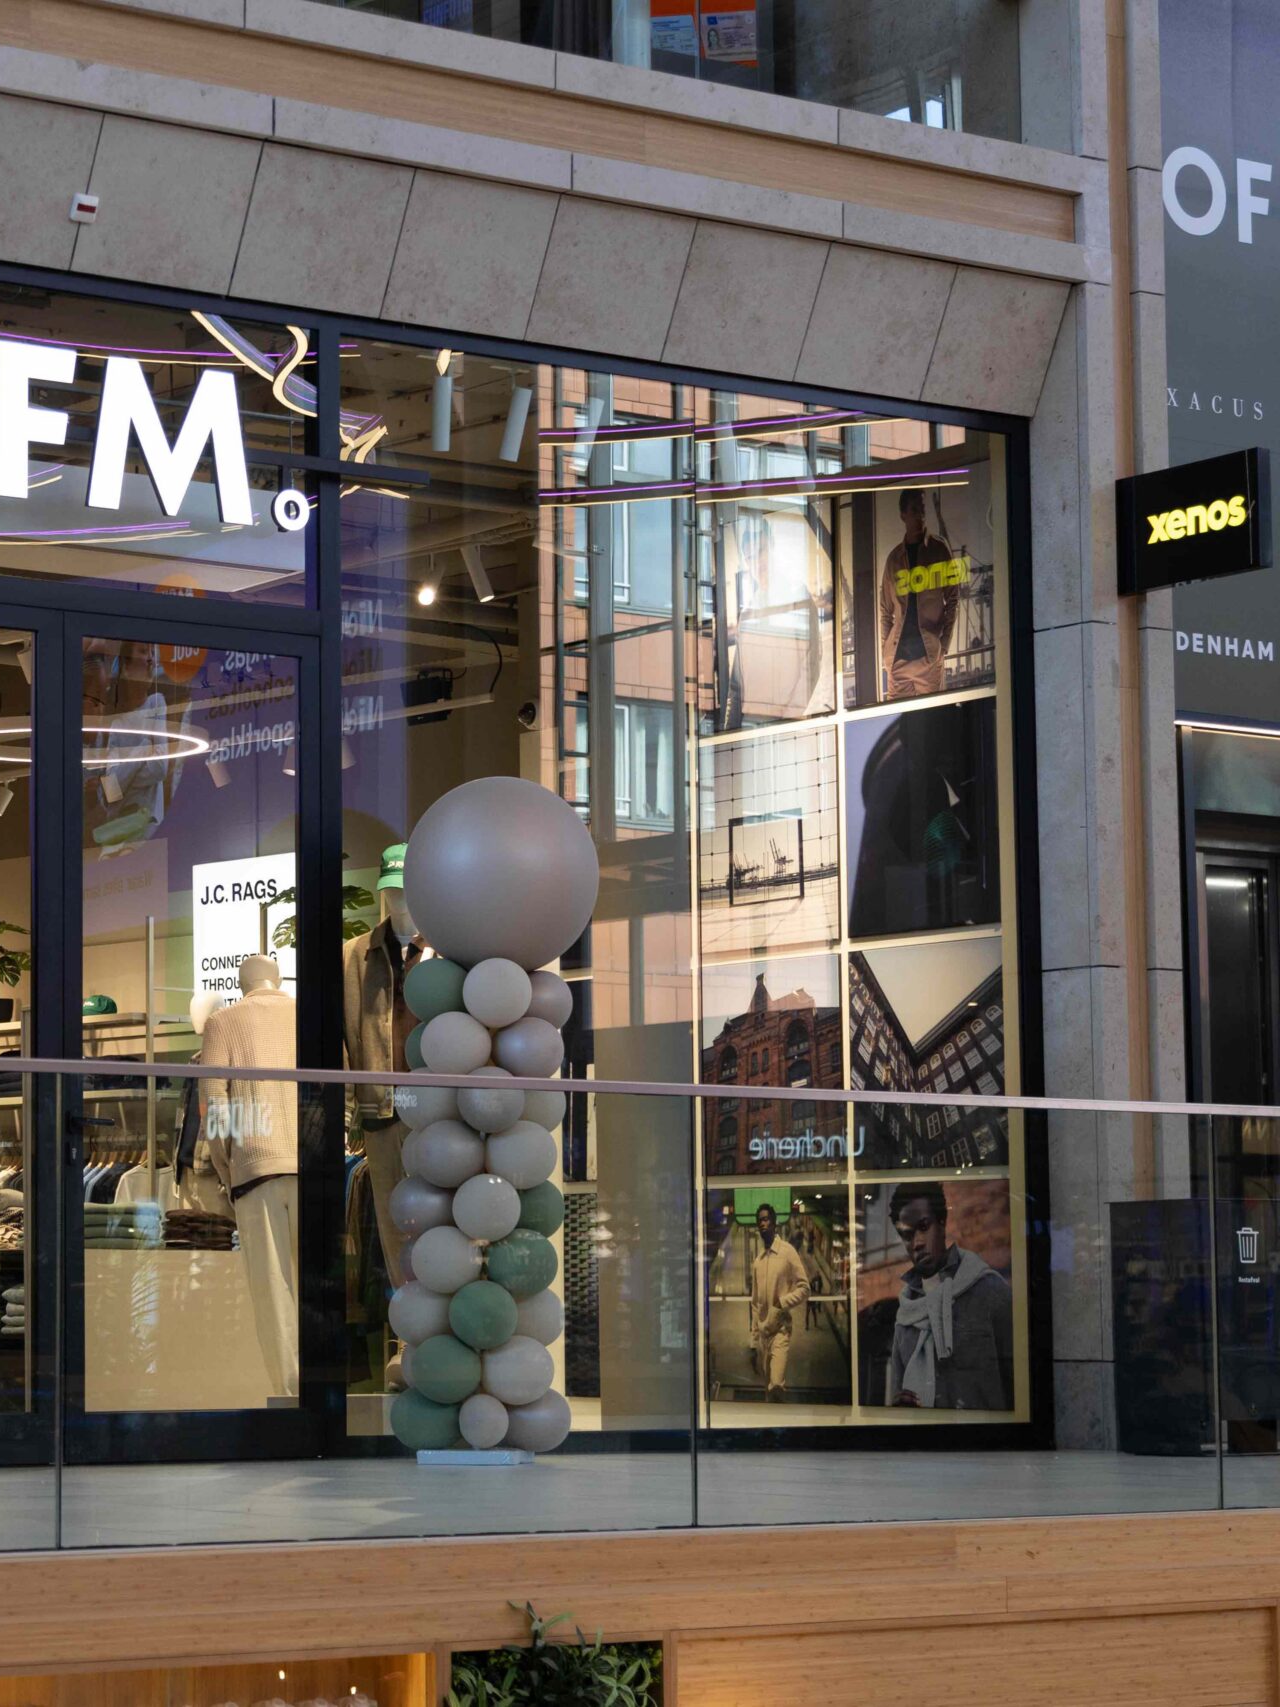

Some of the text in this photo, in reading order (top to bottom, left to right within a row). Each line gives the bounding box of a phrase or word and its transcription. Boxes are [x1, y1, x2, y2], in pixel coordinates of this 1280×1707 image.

[1161, 146, 1272, 244] OF
[1167, 387, 1264, 421] XACUS
[1147, 495, 1247, 544] xenos
[1175, 630, 1274, 661] DENHAM
[231, 878, 277, 901] RAGS
